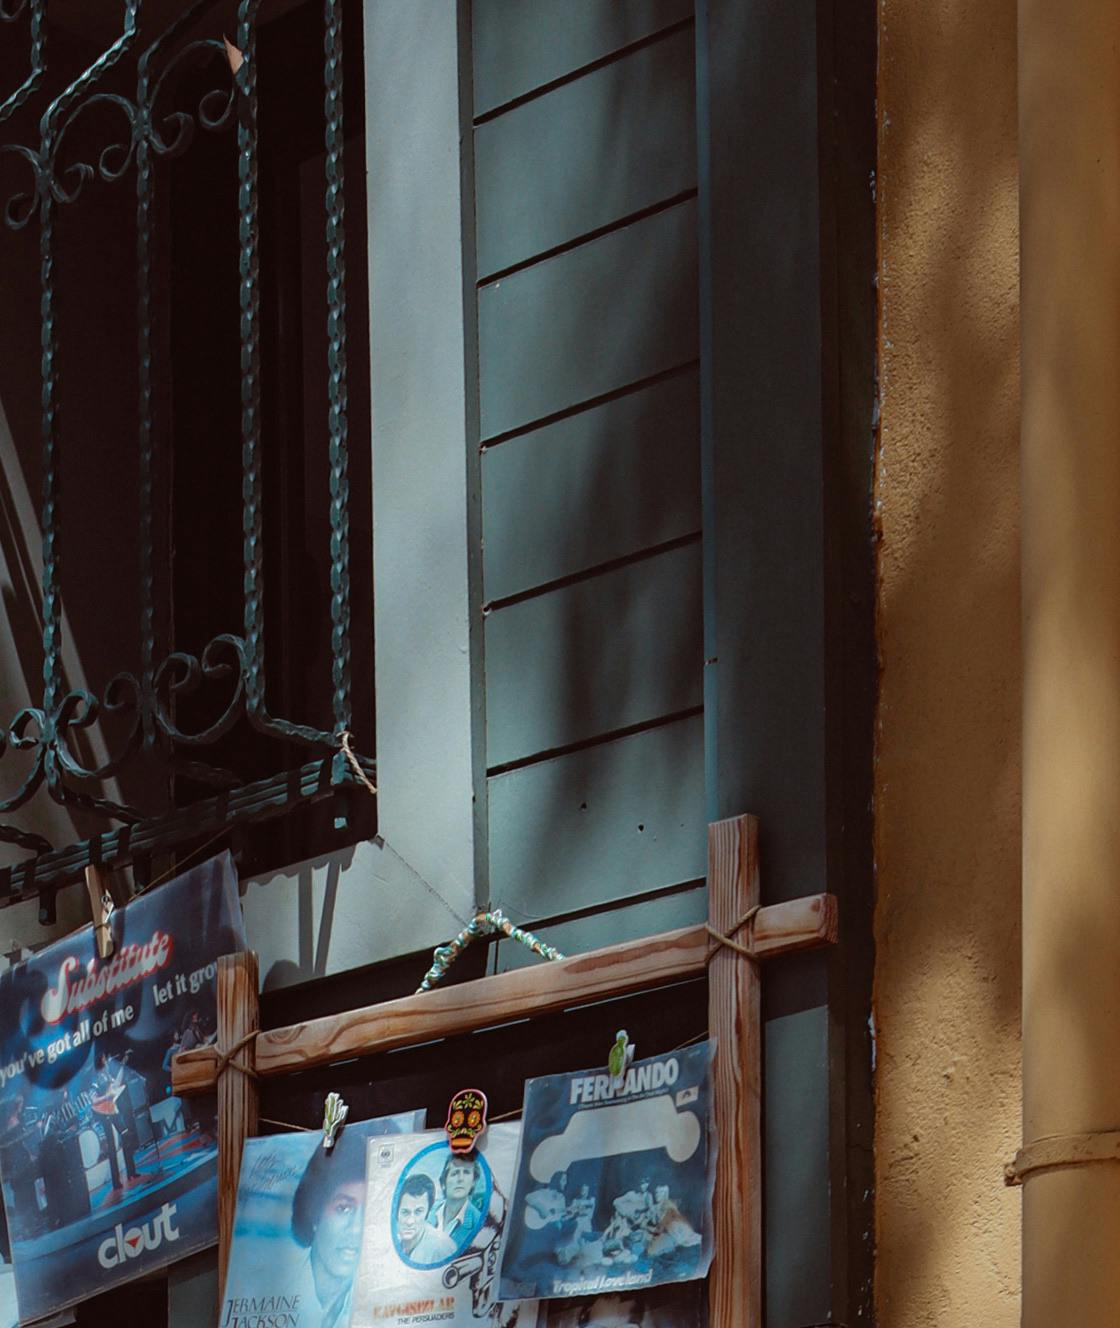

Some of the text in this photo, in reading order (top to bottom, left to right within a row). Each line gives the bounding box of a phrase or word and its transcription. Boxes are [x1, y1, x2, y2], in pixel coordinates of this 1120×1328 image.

[41, 930, 174, 1025] Substitute
[152, 962, 219, 1007] let it gro
[47, 1035, 71, 1065] got
[72, 1018, 91, 1048] all
[93, 1011, 110, 1037] of
[111, 1004, 134, 1028] me
[97, 1202, 180, 1269] clout
[224, 1295, 301, 1328] JERMAINE
[397, 1311, 455, 1325] THE PERSUADERS
